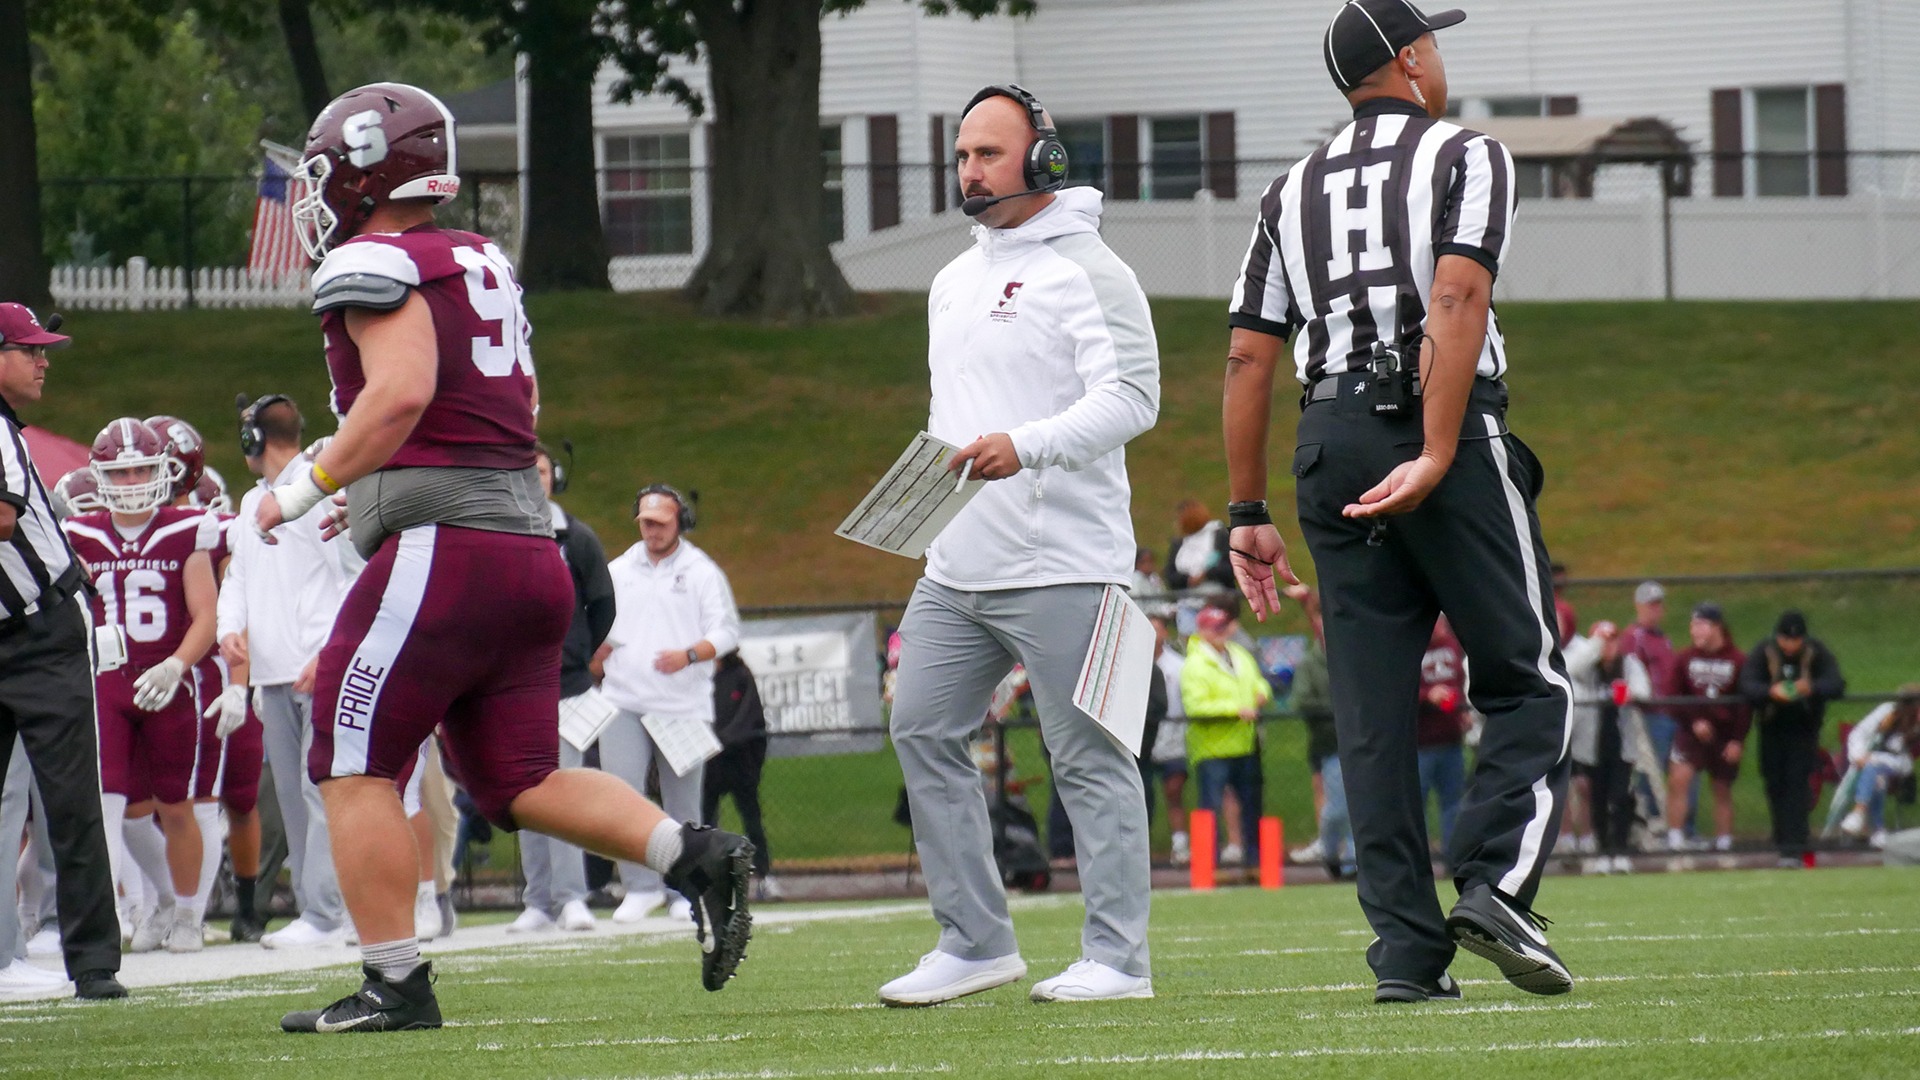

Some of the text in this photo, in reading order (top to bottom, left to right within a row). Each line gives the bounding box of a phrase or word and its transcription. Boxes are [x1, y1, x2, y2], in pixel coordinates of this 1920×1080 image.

[342, 109, 388, 168] S
[1323, 160, 1394, 282] H
[95, 569, 168, 643] 16
[338, 656, 385, 731] PRIDE
